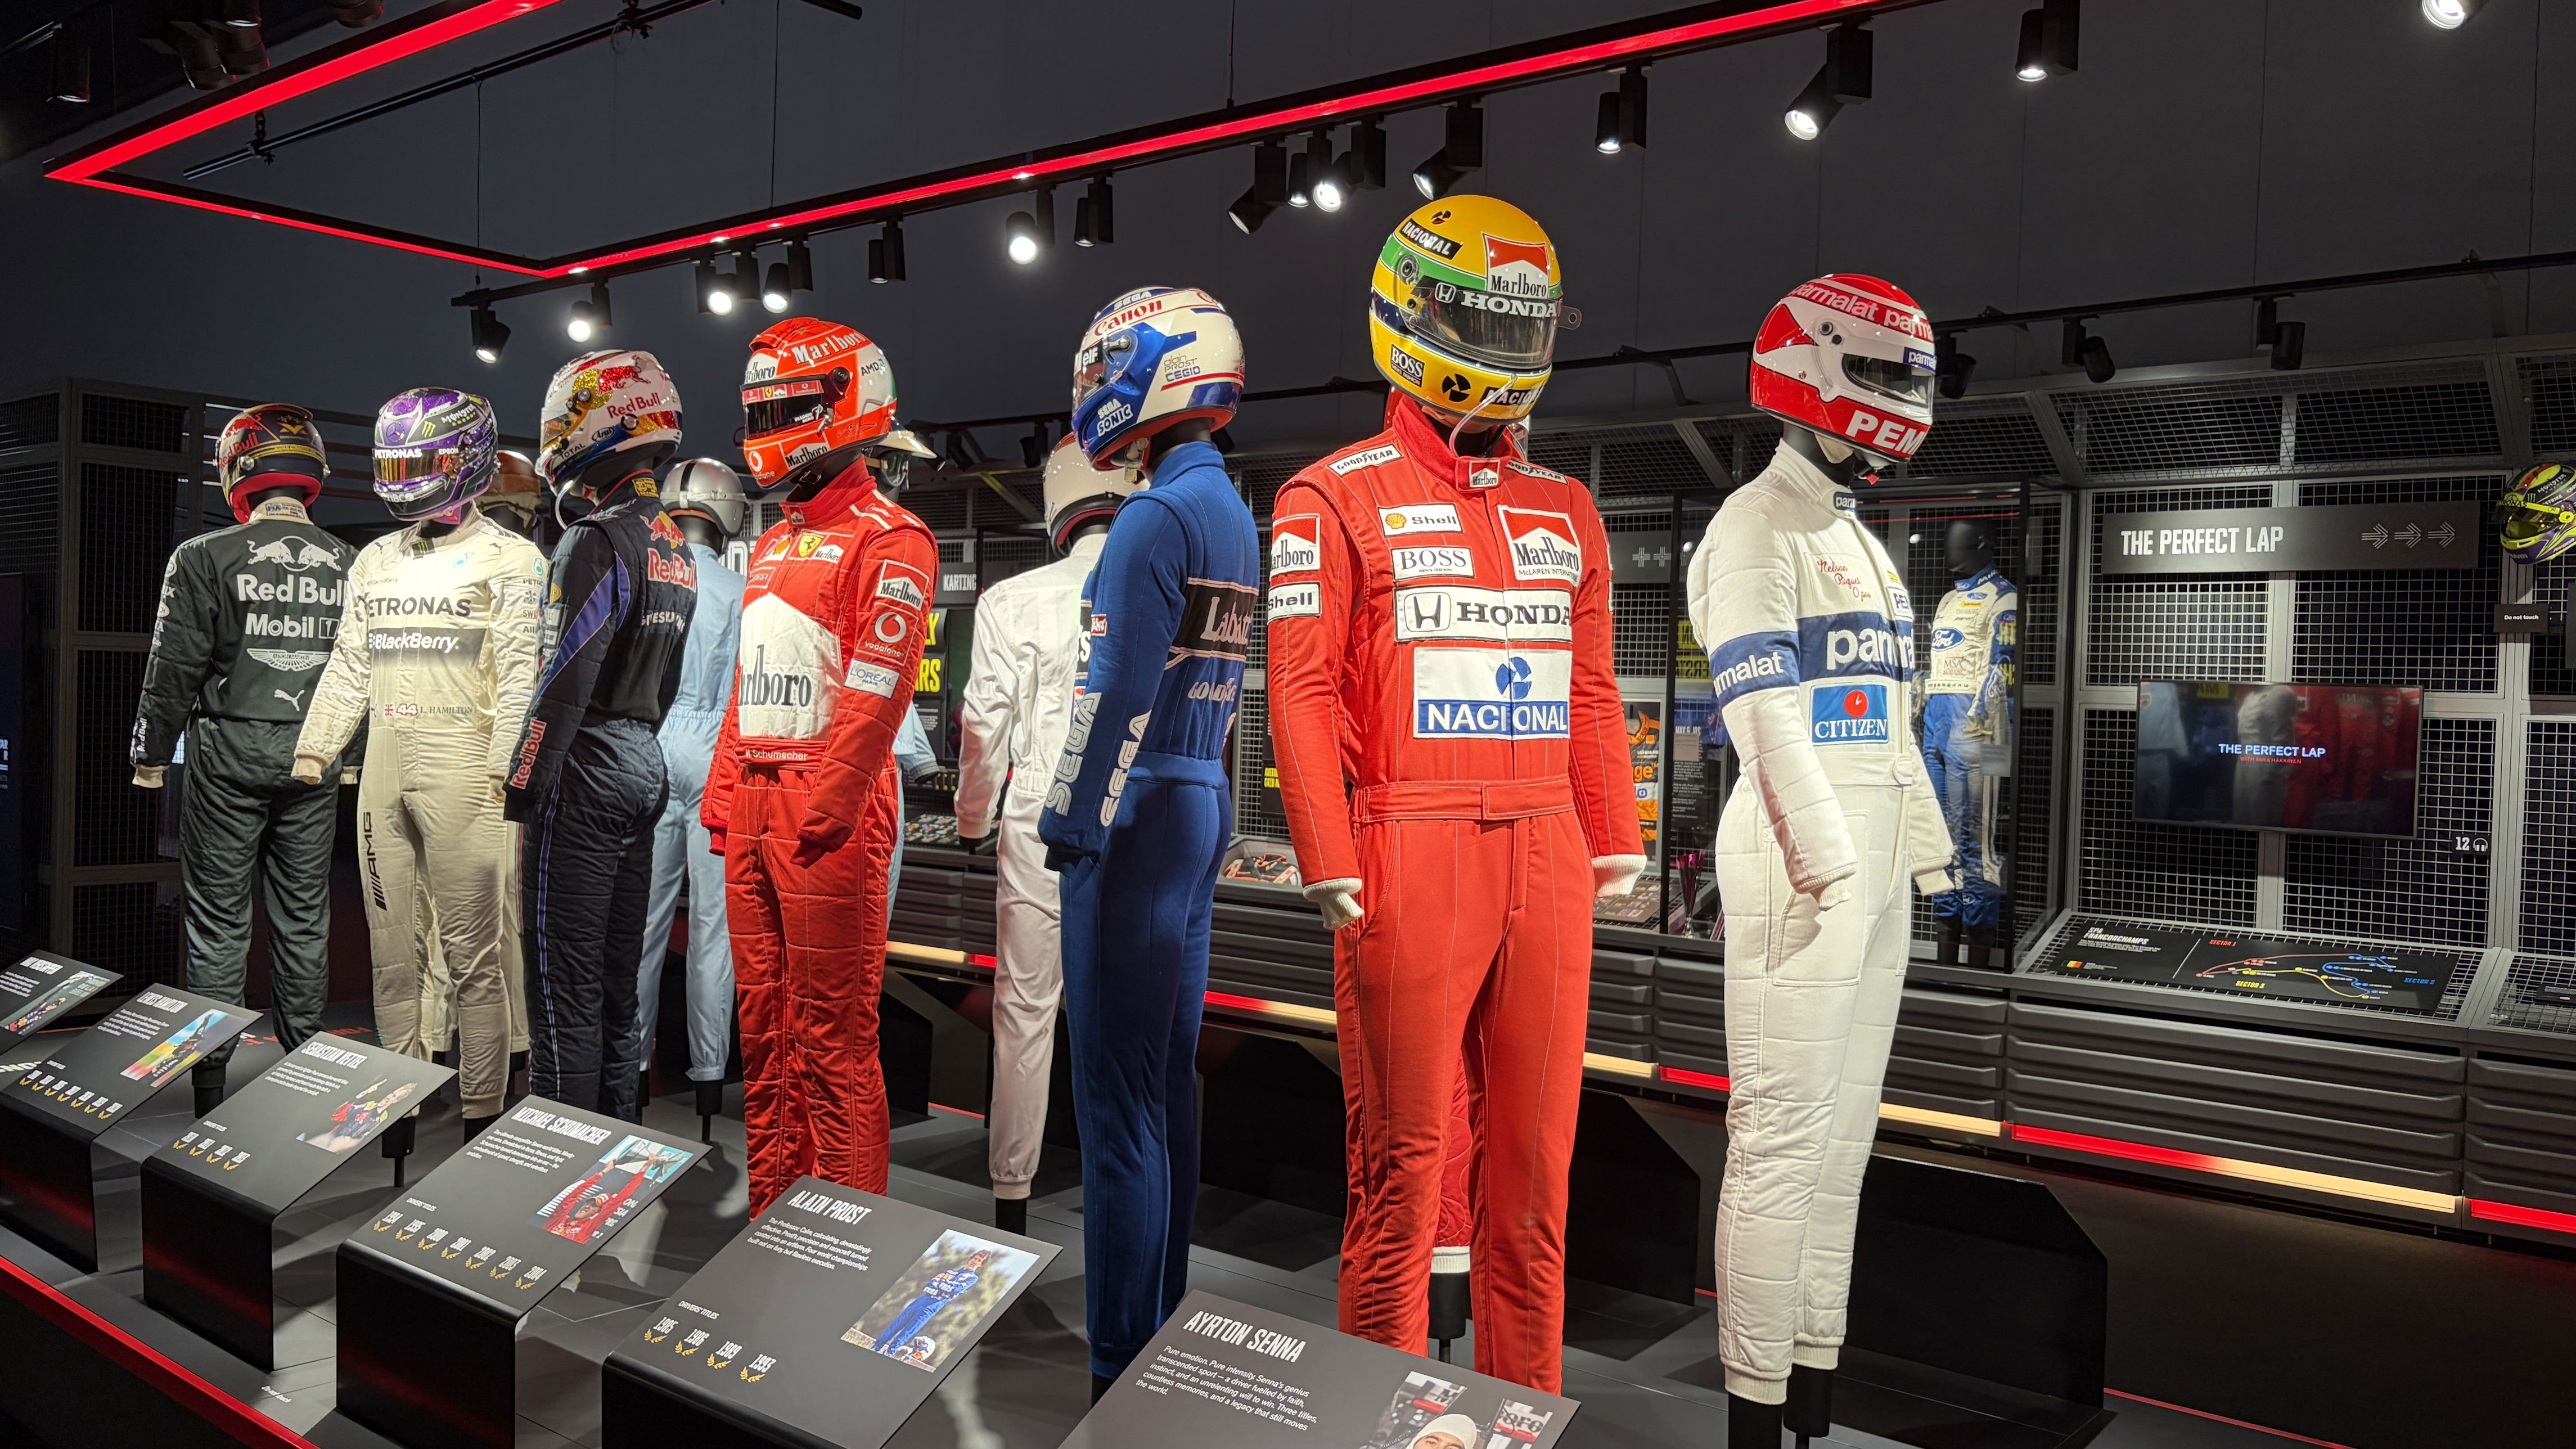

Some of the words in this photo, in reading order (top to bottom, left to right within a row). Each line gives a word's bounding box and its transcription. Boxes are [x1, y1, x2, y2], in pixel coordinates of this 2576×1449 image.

[1402, 221, 1449, 256] NACIONAL
[1490, 273, 1547, 296] Marlboro
[1114, 291, 1152, 310] SEGA
[1461, 290, 1557, 317] HONDA
[1789, 283, 1879, 322] parmalat
[1095, 300, 1162, 336] Canon
[1083, 347, 1098, 364] elf
[1164, 358, 1197, 372] PROST
[1391, 346, 1424, 379] BOSS
[861, 363, 879, 376] AMD
[1165, 366, 1201, 382] CEGID
[607, 398, 635, 418] Red
[636, 392, 661, 410] Bull
[1097, 398, 1122, 419] SEGA
[1097, 403, 1134, 437] SONIC
[233, 432, 259, 453] Bull
[596, 428, 613, 439] Arai
[375, 448, 422, 458] PETRONAS
[785, 445, 828, 468] Marlboro
[1337, 449, 1393, 470] GOODYEAR
[1472, 471, 1497, 485] Marlboro
[1412, 515, 1457, 525] Shell
[2121, 530, 2154, 556] THE
[2159, 526, 2240, 555] PERFECT
[2246, 526, 2284, 552] LAP
[1400, 549, 1467, 570] BOSS
[1514, 537, 1579, 572] Marlboro
[648, 548, 675, 584] Red
[1817, 560, 1848, 573] Nelson
[237, 574, 294, 602] Red
[299, 577, 346, 607] Bull
[943, 574, 977, 591] KARTING
[1834, 573, 1861, 588] Piquet
[880, 579, 922, 607] Marlboro
[1268, 592, 1312, 611] Shell
[1457, 601, 1571, 627] HONDA
[245, 613, 314, 638] Mobil
[1931, 630, 1954, 647] Ford
[864, 641, 902, 658] vodafone
[397, 703, 418, 716] 44
[1428, 704, 1567, 732] NACIONAL
[138, 718, 147, 734] Bull
[1815, 718, 1887, 739] CITIZEN
[137, 734, 146, 752] Red
[2219, 743, 2241, 754] THE
[2245, 744, 2299, 757] PERFECT
[2302, 746, 2326, 758] LAP
[510, 752, 535, 790] Red
[524, 719, 547, 755] Bull
[753, 749, 808, 761] Schumacher
[1045, 692, 1102, 816] SEGA
[2456, 836, 2470, 851] 12
[2083, 933, 2149, 945] FRANCORCHAMPS
[301, 1042, 346, 1061] SEBASTIAN
[336, 1051, 367, 1069] VETTEL
[511, 1106, 556, 1128] MICHAEL
[547, 1117, 611, 1145] SCHUMACHER
[787, 1190, 833, 1213] ALAIN
[823, 1200, 872, 1225] PROST
[382, 1210, 403, 1224] 1994
[404, 1219, 426, 1233] 1995
[426, 1227, 449, 1242] 2000
[450, 1237, 472, 1252] 2001
[474, 1246, 497, 1261] 2002
[498, 1256, 522, 1271] 2003
[523, 1266, 547, 1281] 2004
[782, 1230, 798, 1239] Prost's
[796, 1236, 819, 1245] precision
[829, 1246, 852, 1256] racecraft
[850, 1252, 869, 1261] turned
[792, 1251, 812, 1261] flawless
[840, 1240, 872, 1254] devastatingly
[831, 1256, 868, 1271] championships
[700, 1307, 719, 1320] TITLES
[653, 1316, 679, 1334] 1985
[684, 1329, 710, 1347] 1986
[715, 1341, 742, 1360] 1989
[749, 1353, 777, 1373] 1993
[1183, 1311, 1253, 1345] AYRTON
[1246, 1329, 1305, 1362] SENNA
[1157, 1354, 1199, 1371] transcended
[1198, 1369, 1217, 1378] sport
[1231, 1379, 1251, 1388] driver
[1252, 1384, 1277, 1397] fuelled
[1277, 1393, 1287, 1401] by
[1287, 1396, 1304, 1407] faith,
[1164, 1346, 1179, 1355] Pure
[1181, 1353, 1208, 1365] emotion.
[1209, 1360, 1226, 1370] Pure
[1226, 1365, 1255, 1380] intensity.
[1257, 1375, 1284, 1389] Senna's
[1284, 1386, 1309, 1397] genius
[1149, 1385, 1168, 1394] world.
[1150, 1364, 1175, 1376] instinct,
[1200, 1380, 1239, 1397] unrelenting
[1277, 1403, 1297, 1415] Three
[1298, 1411, 1317, 1423] titles,
[1143, 1372, 1175, 1385] countless
[1175, 1383, 1209, 1398] memories,
[1231, 1400, 1254, 1413] legacy
[1254, 1408, 1270, 1418] that
[1284, 1419, 1308, 1430] moves
